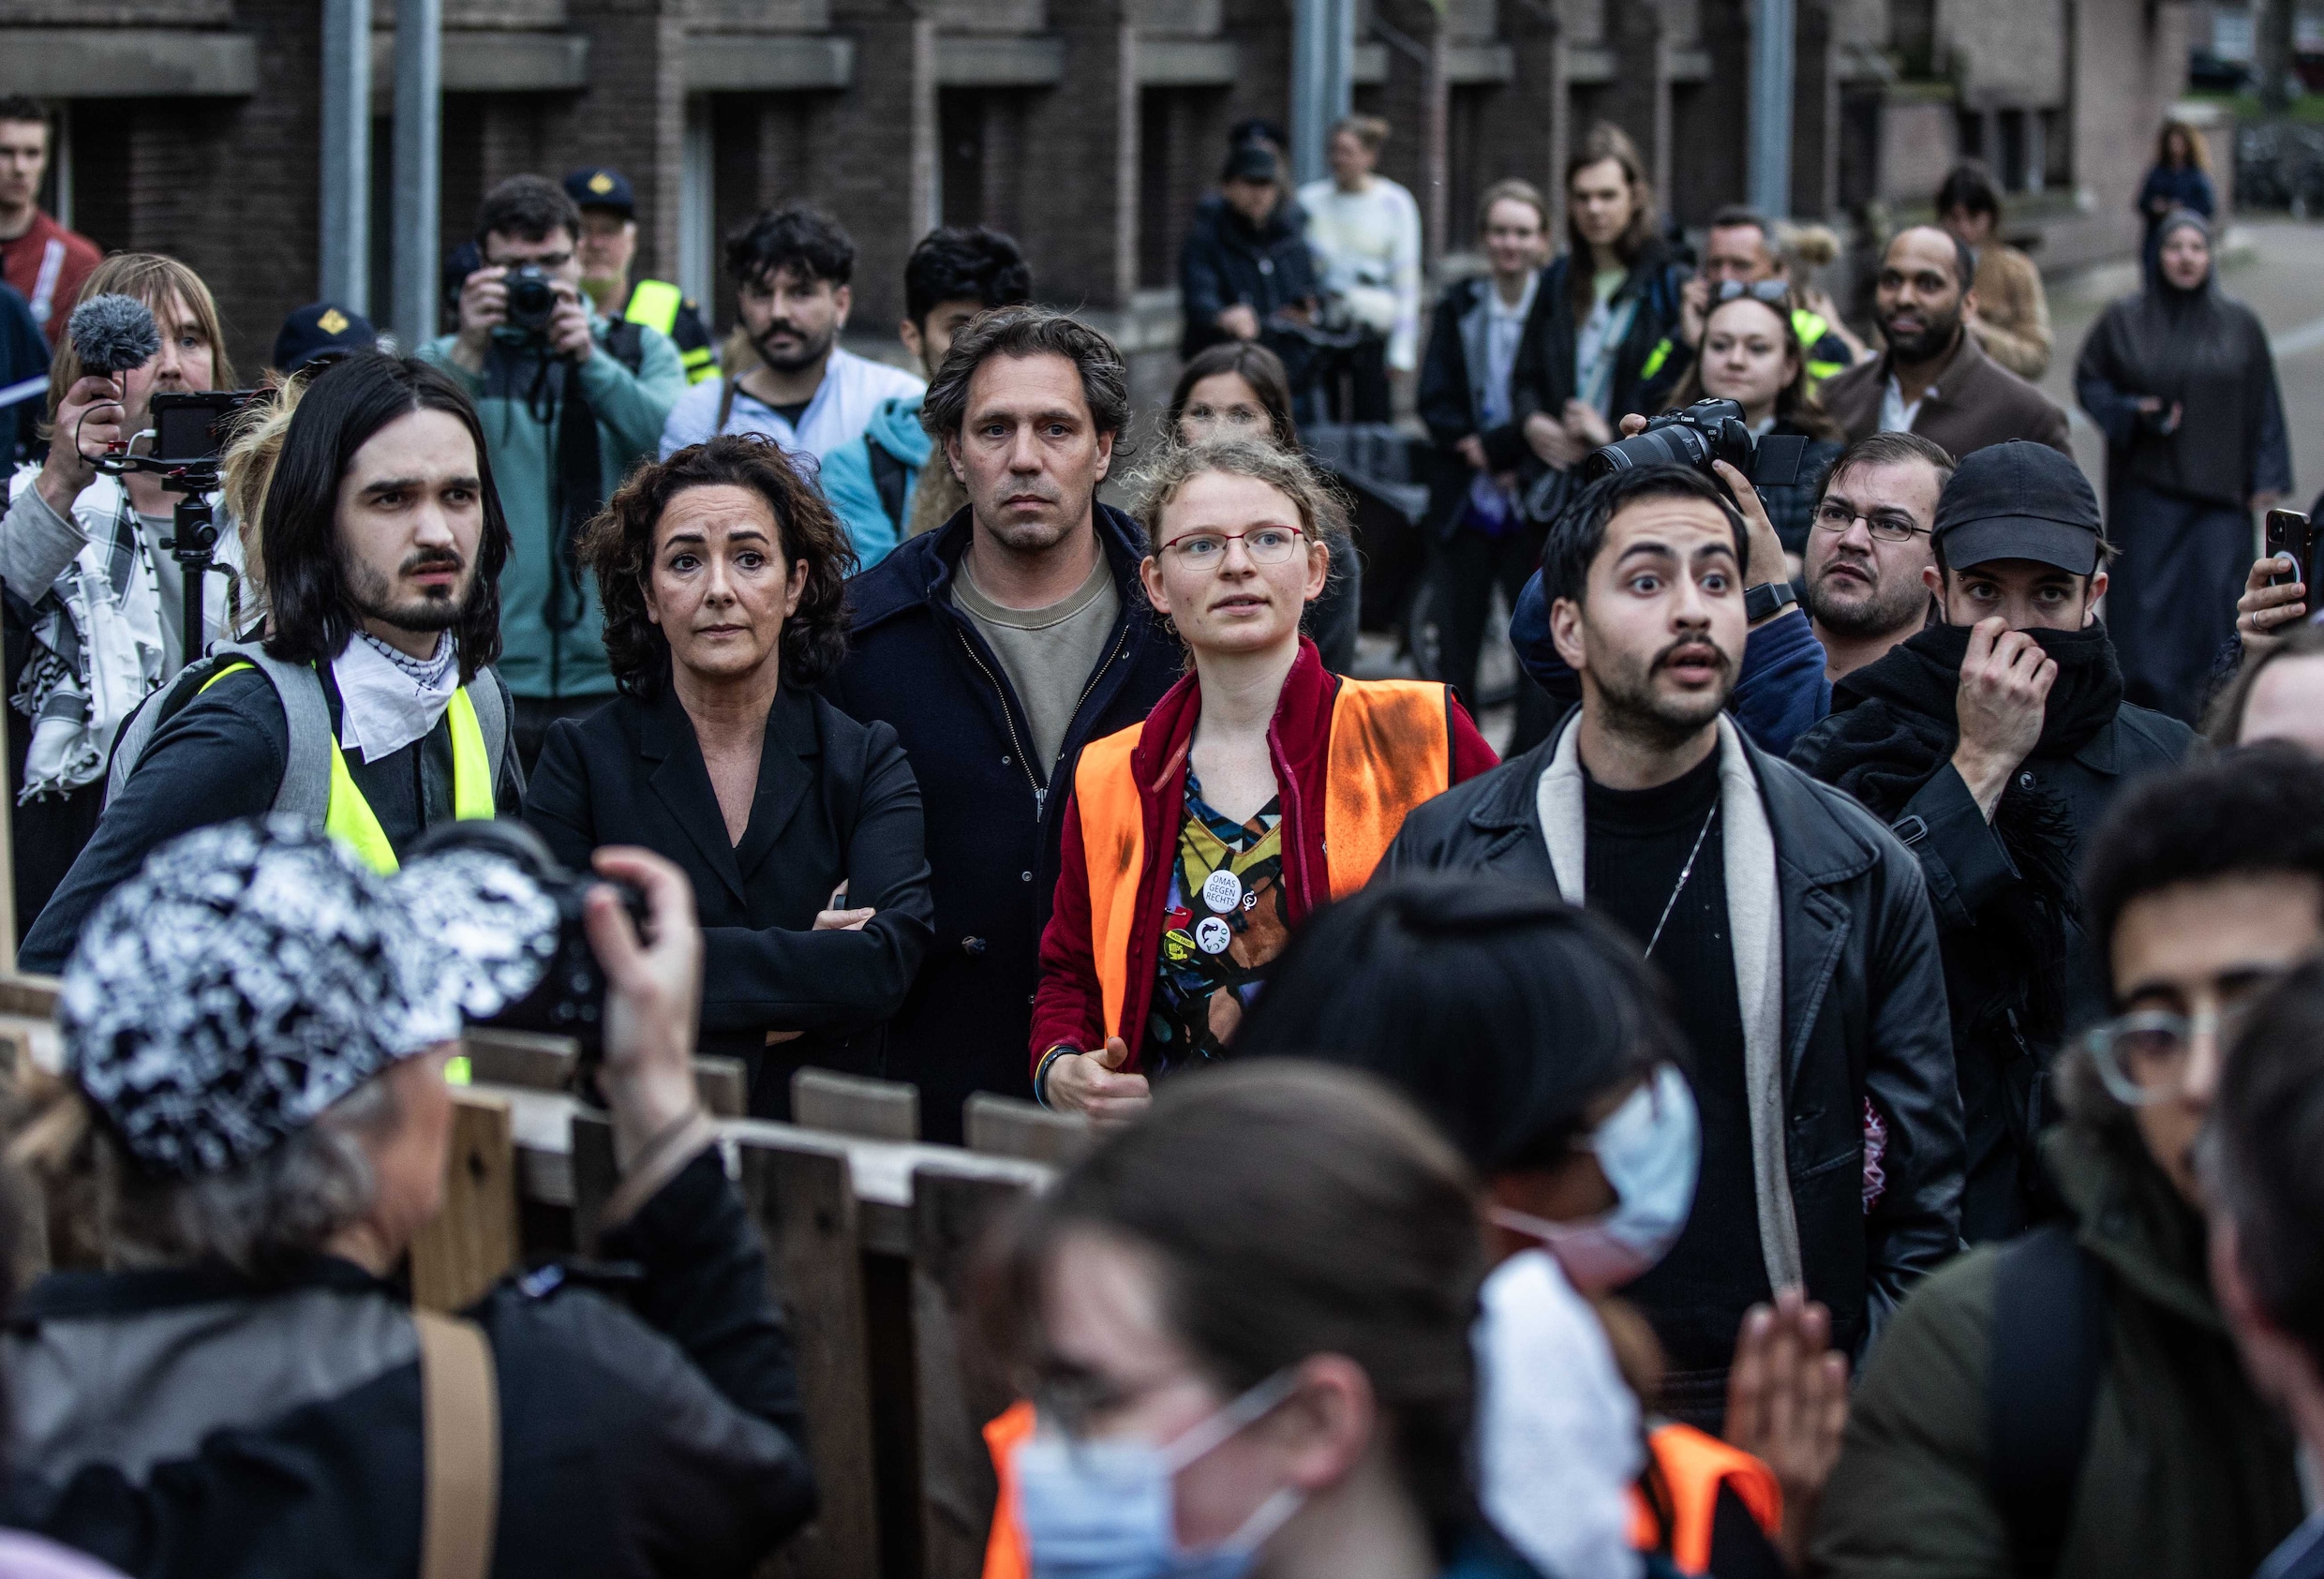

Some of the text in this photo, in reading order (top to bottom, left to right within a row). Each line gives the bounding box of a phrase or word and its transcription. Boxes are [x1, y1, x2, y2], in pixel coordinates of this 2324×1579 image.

[1213, 874, 1236, 888] OMAS
[1209, 883, 1236, 898] GEGEN
[1205, 891, 1235, 907] RECHTS
[1205, 928, 1228, 951] ORCA
